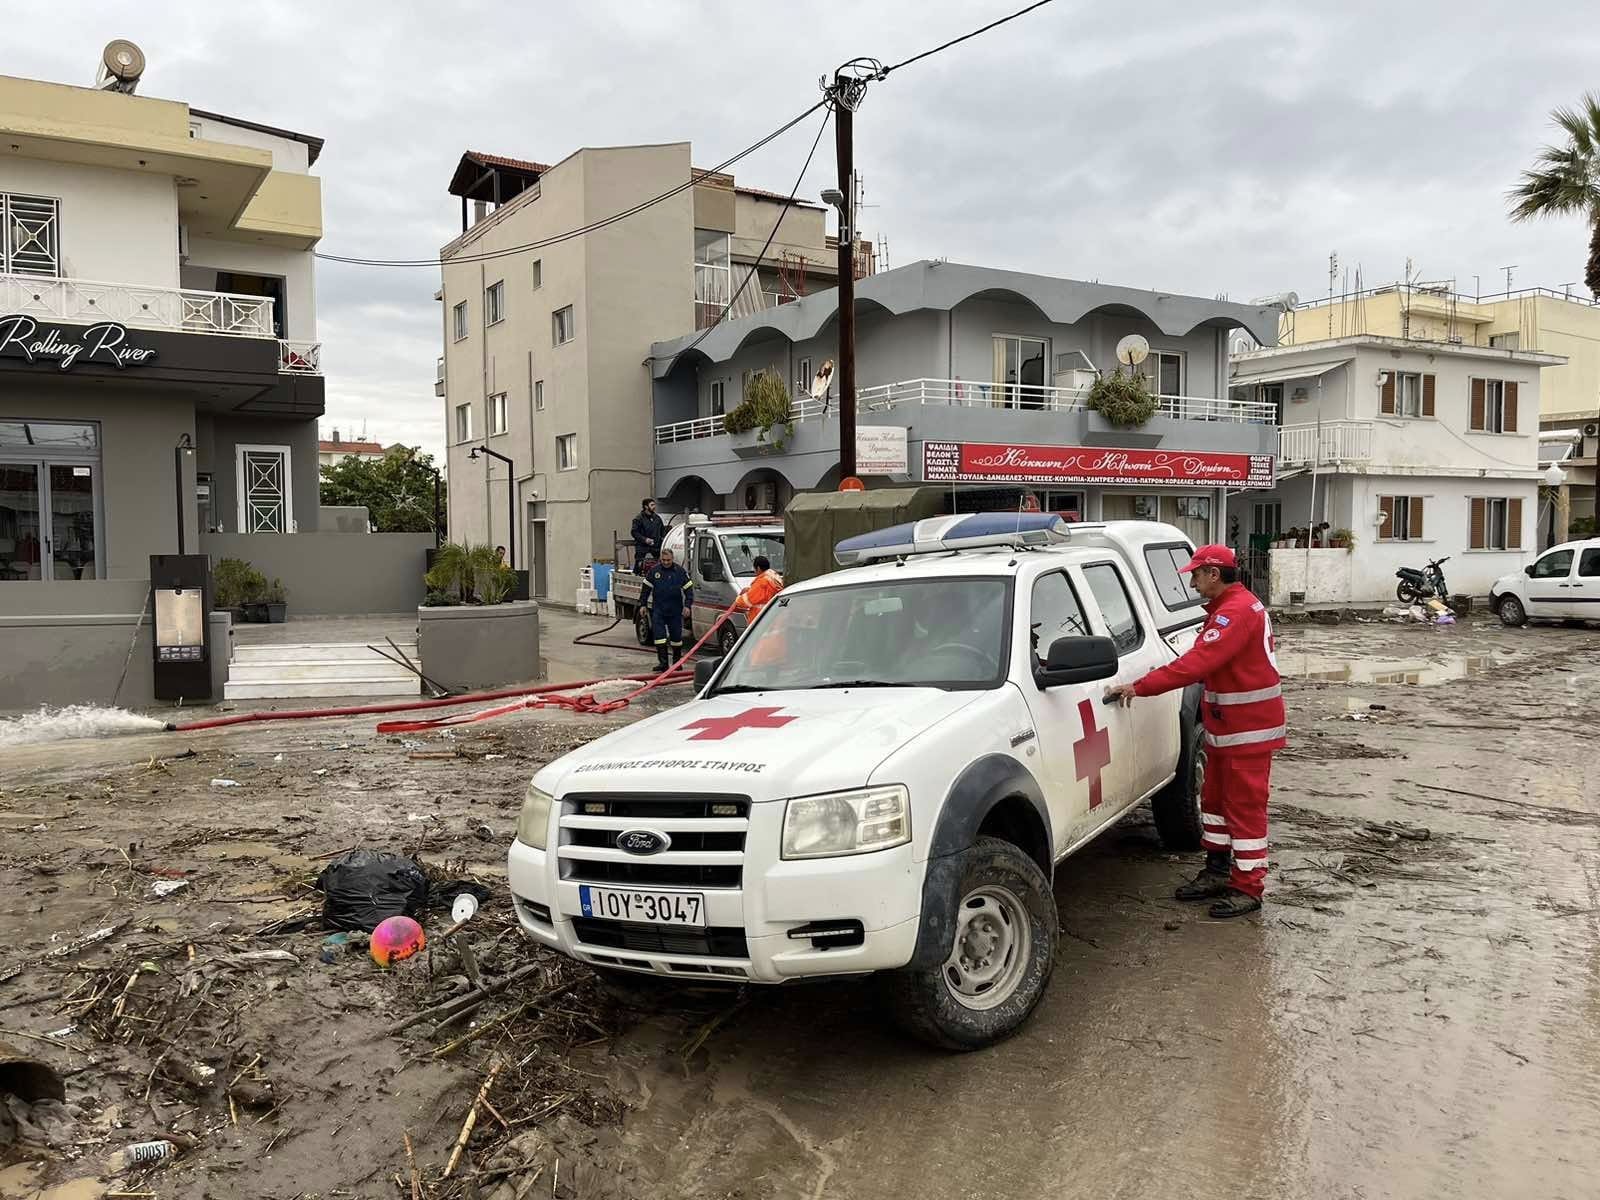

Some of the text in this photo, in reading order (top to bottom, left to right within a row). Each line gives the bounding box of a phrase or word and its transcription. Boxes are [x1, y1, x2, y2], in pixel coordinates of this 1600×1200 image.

[0, 315, 155, 369] Rolling River
[928, 443, 958, 451] ΨΑΛΙΔΙΑ
[701, 760, 767, 773] ΣΤΑΥΡΟΣ
[627, 833, 654, 848] Ford
[134, 1143, 166, 1160] BOOST
